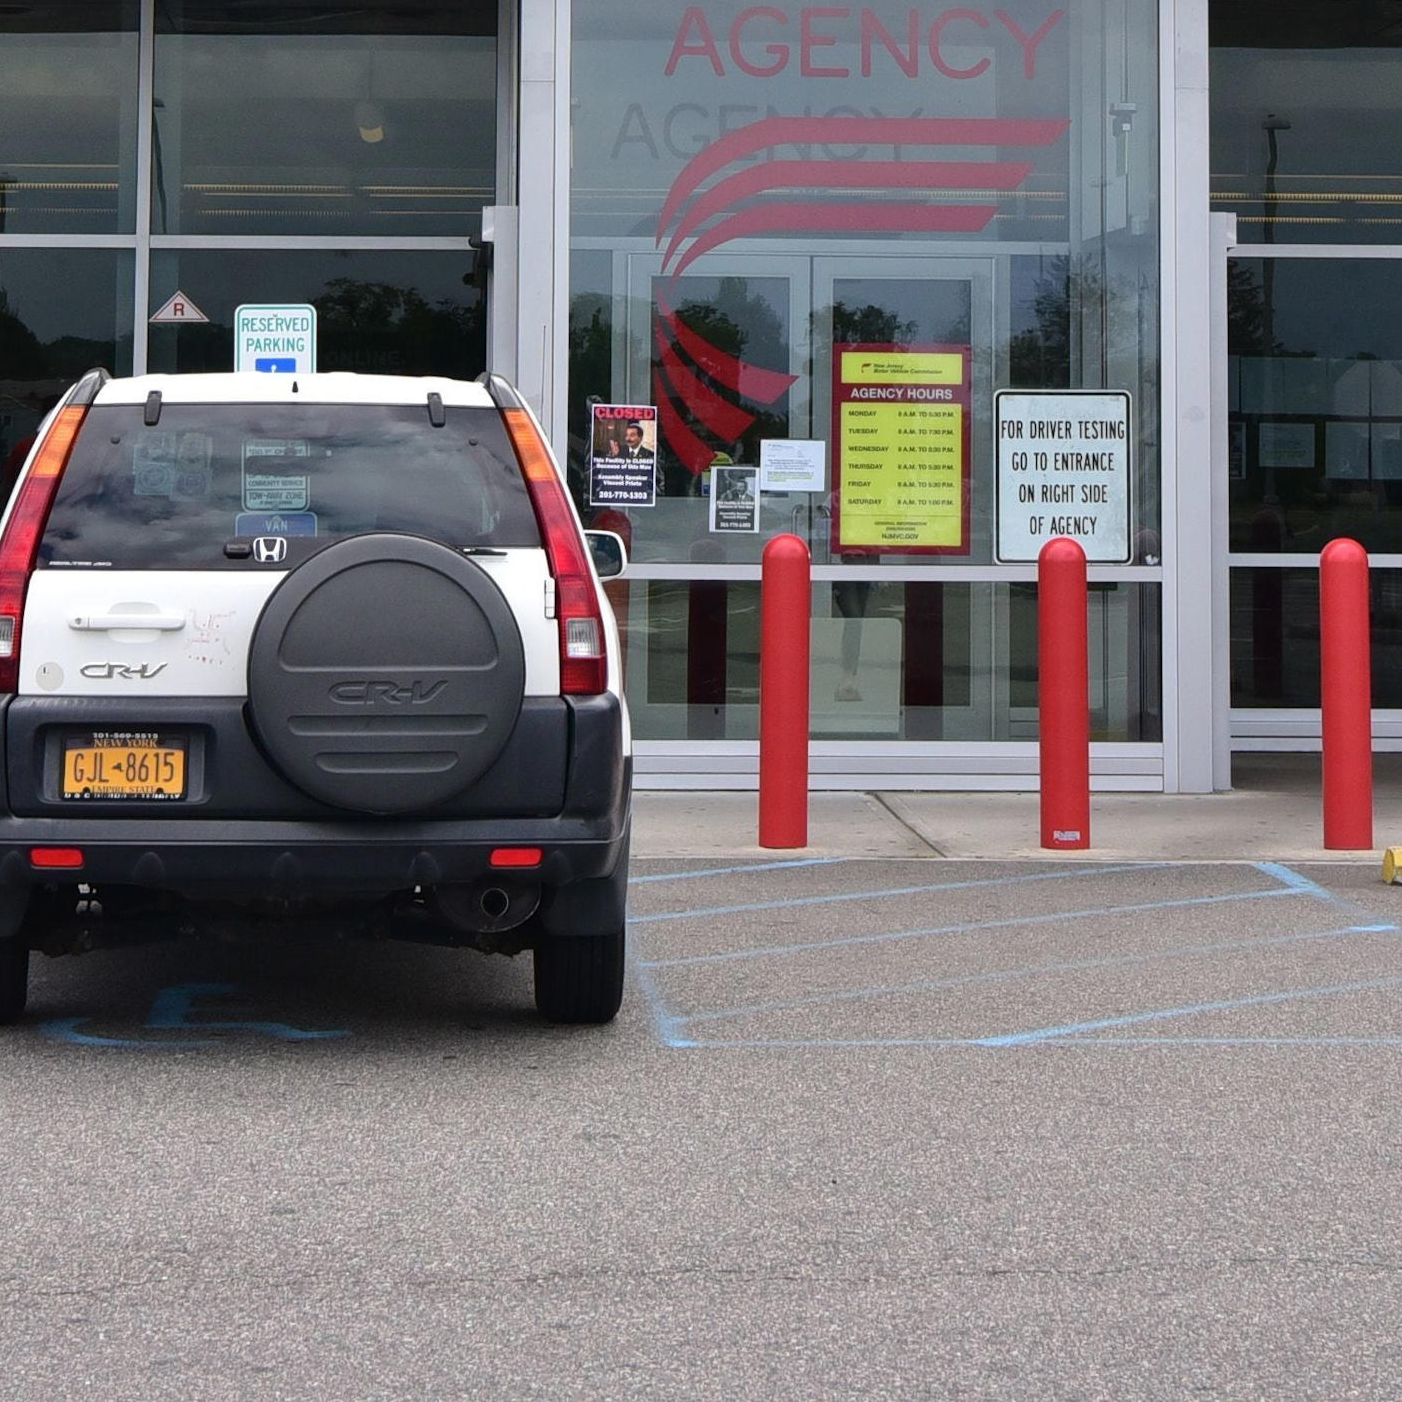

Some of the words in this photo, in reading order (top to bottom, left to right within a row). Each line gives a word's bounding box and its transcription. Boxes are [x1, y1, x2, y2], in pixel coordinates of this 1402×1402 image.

[664, 6, 1064, 80] AGENCY
[173, 302, 185, 316] R
[241, 317, 309, 332] RESERVED
[246, 338, 305, 352] PARKING
[850, 388, 905, 398] AGENCY
[907, 389, 953, 399] HOURS
[595, 407, 654, 420] CLOSED
[1001, 420, 1023, 439] FOR
[1030, 421, 1072, 439] DRIVER
[1078, 421, 1125, 439] TESTING
[1012, 452, 1028, 471] GO
[1034, 452, 1047, 471] TO
[1054, 453, 1115, 471] ENTRANCE
[599, 491, 647, 499] 201-770-1303
[1018, 484, 1035, 503] ON
[1041, 484, 1075, 503] RIGHT
[1081, 484, 1108, 503] SIDE
[265, 520, 288, 532] VAN
[1030, 516, 1044, 535] OF
[1050, 516, 1097, 535] AGENCY
[80, 662, 168, 679] CR-V
[328, 680, 448, 705] CR-V
[93, 739, 123, 748] NEW
[125, 739, 158, 748] YORK
[126, 752, 175, 783] 8615
